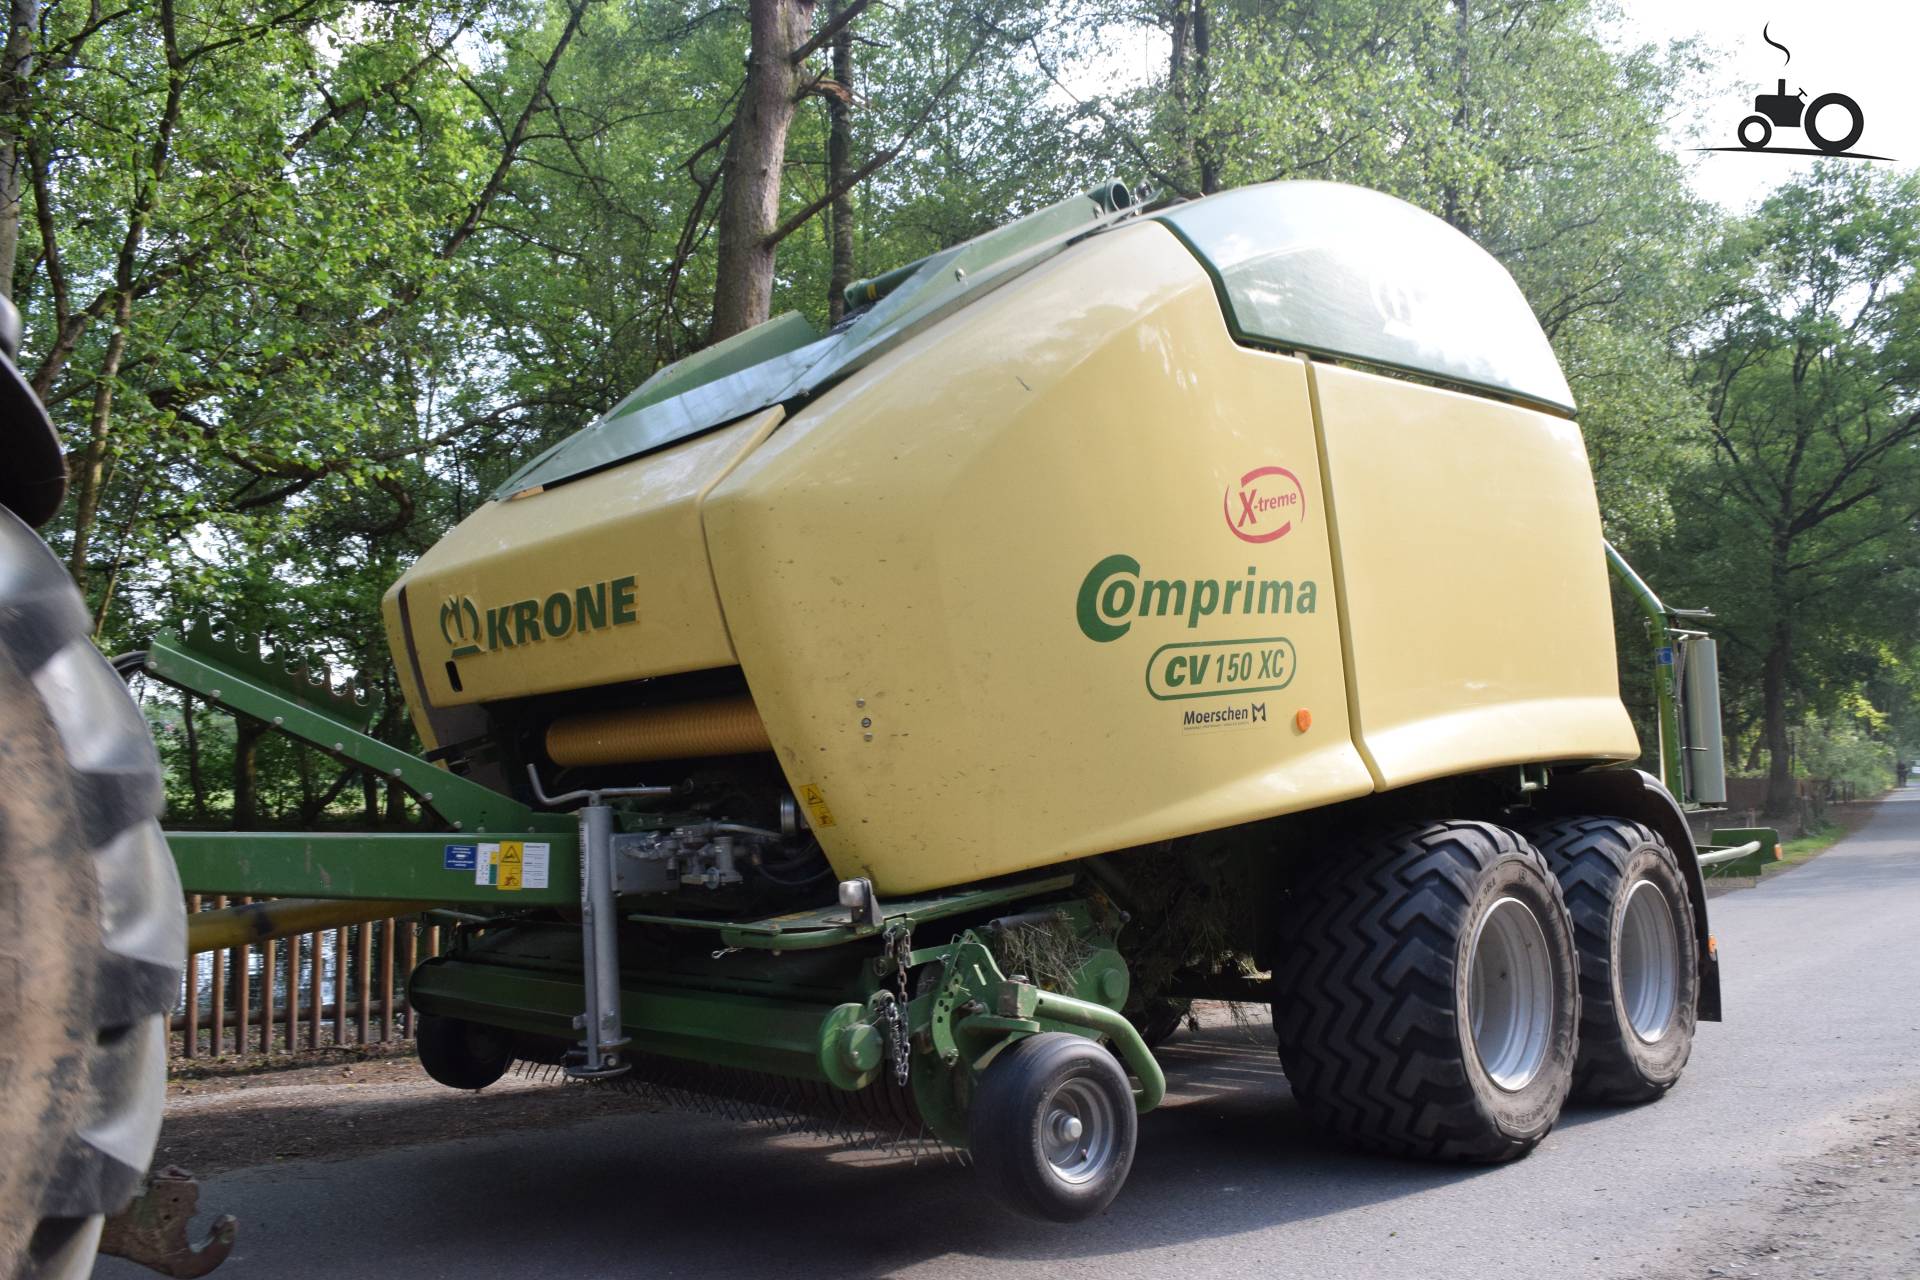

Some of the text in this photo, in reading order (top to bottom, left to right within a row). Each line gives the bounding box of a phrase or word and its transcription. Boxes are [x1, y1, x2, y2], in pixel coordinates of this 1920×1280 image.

[1237, 489, 1297, 527] X-treme
[486, 576, 638, 651] KRONE
[1076, 554, 1317, 643] Comprima
[1164, 649, 1285, 687] CV 150 XC
[1183, 705, 1248, 725] Moerschen
